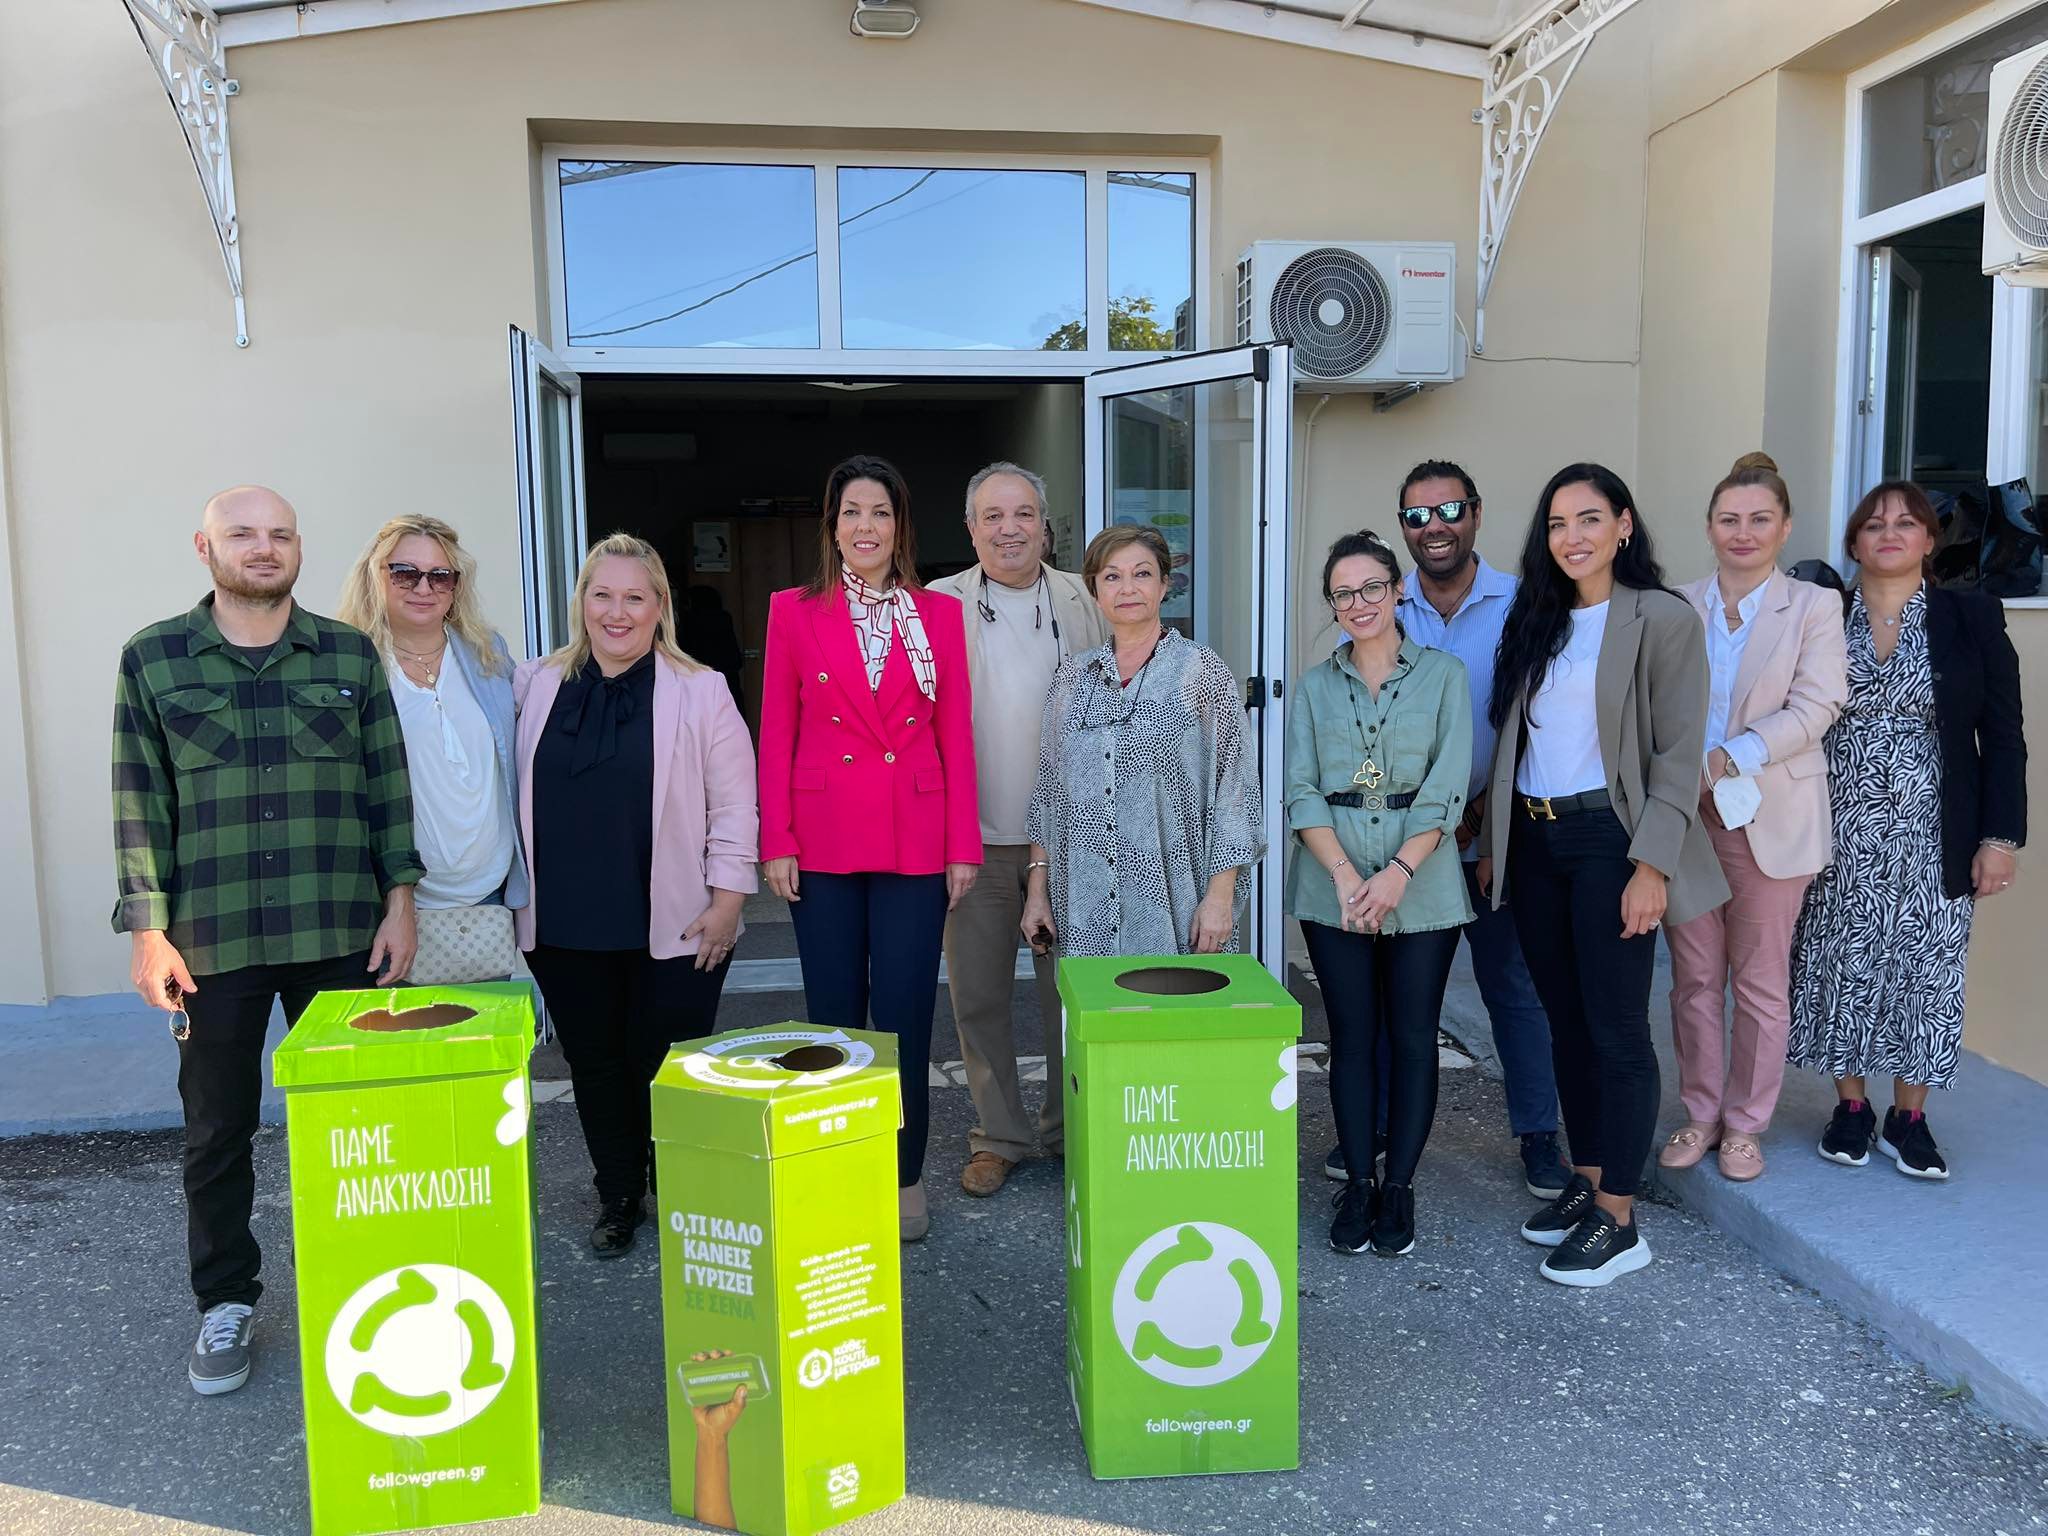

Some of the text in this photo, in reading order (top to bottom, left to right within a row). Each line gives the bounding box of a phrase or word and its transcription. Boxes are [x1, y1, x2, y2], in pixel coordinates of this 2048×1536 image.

[1412, 270, 1446, 278] inventor
[1124, 1085, 1180, 1123] ΠΑΜΕ
[331, 1124, 396, 1168] ΠΑΜΕ
[1126, 1129, 1265, 1171] ΑΝΑΚΥΚΛΩΣΗ!
[335, 1165, 493, 1218] ΑΝΑΚΥΚΛΩΣΗ!
[671, 1211, 763, 1247] Ο,ΤΙ ΚΑΛΟ
[684, 1238, 752, 1270] ΚΑΝΕΙΣ
[684, 1263, 754, 1296] ΓΥΡΙΖΕΙ
[1146, 1418, 1252, 1435] followgreen.gr
[368, 1465, 487, 1490] followgreen.gr
